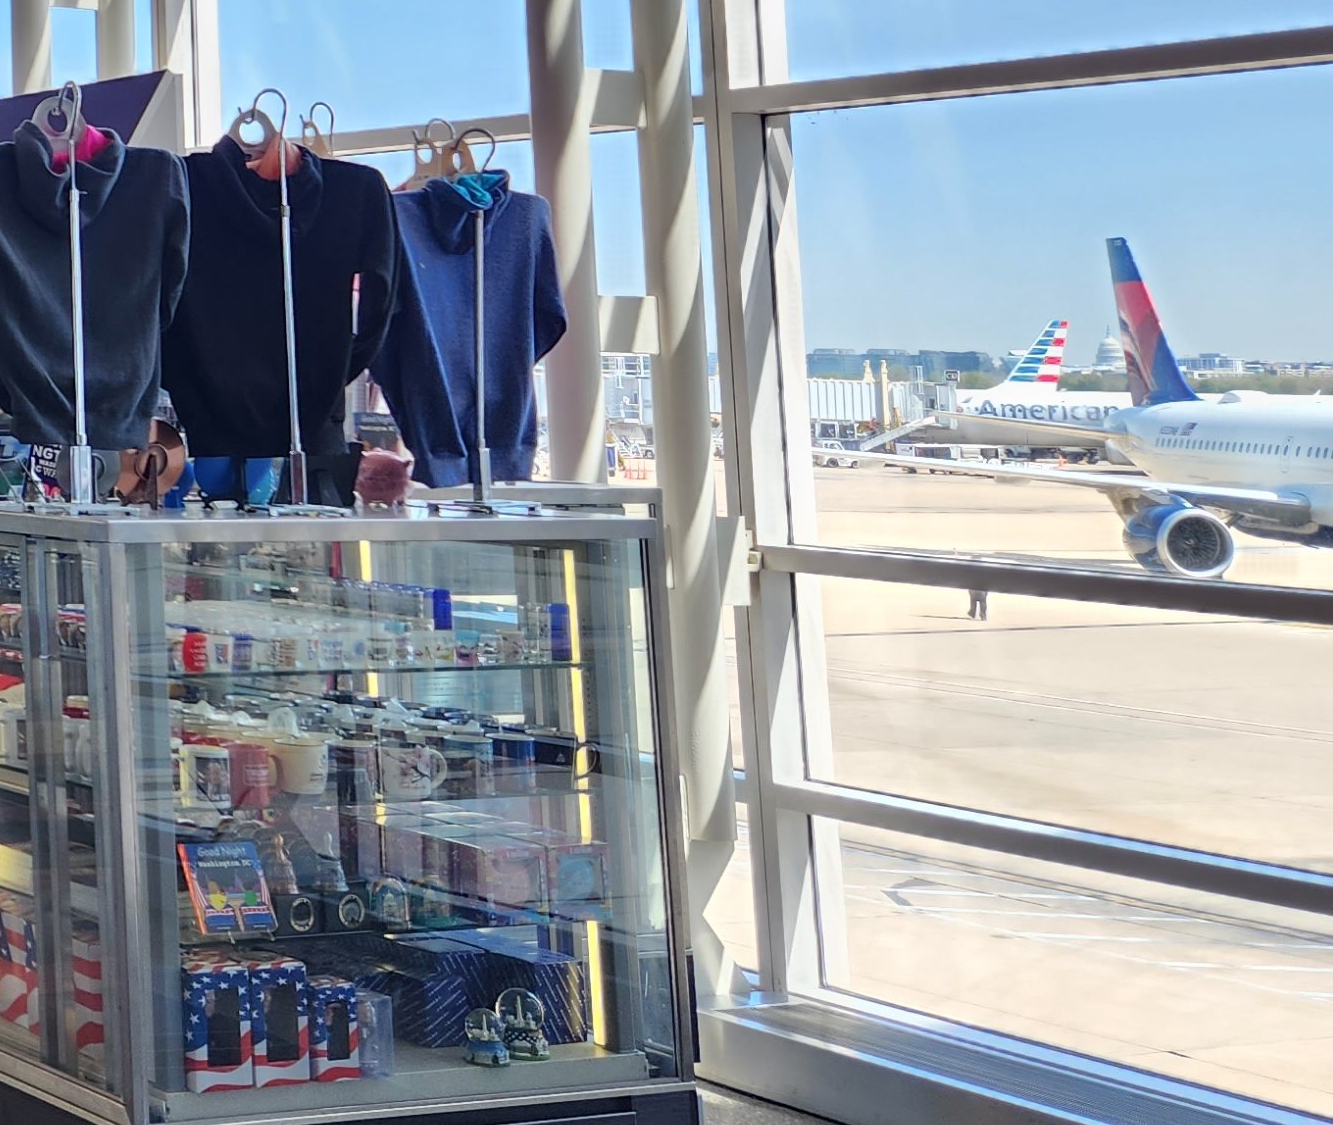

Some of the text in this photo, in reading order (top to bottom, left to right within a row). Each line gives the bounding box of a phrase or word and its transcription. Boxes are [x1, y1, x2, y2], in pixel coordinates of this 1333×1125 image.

[978, 399, 1119, 421] American
[197, 845, 245, 859] Good Night
